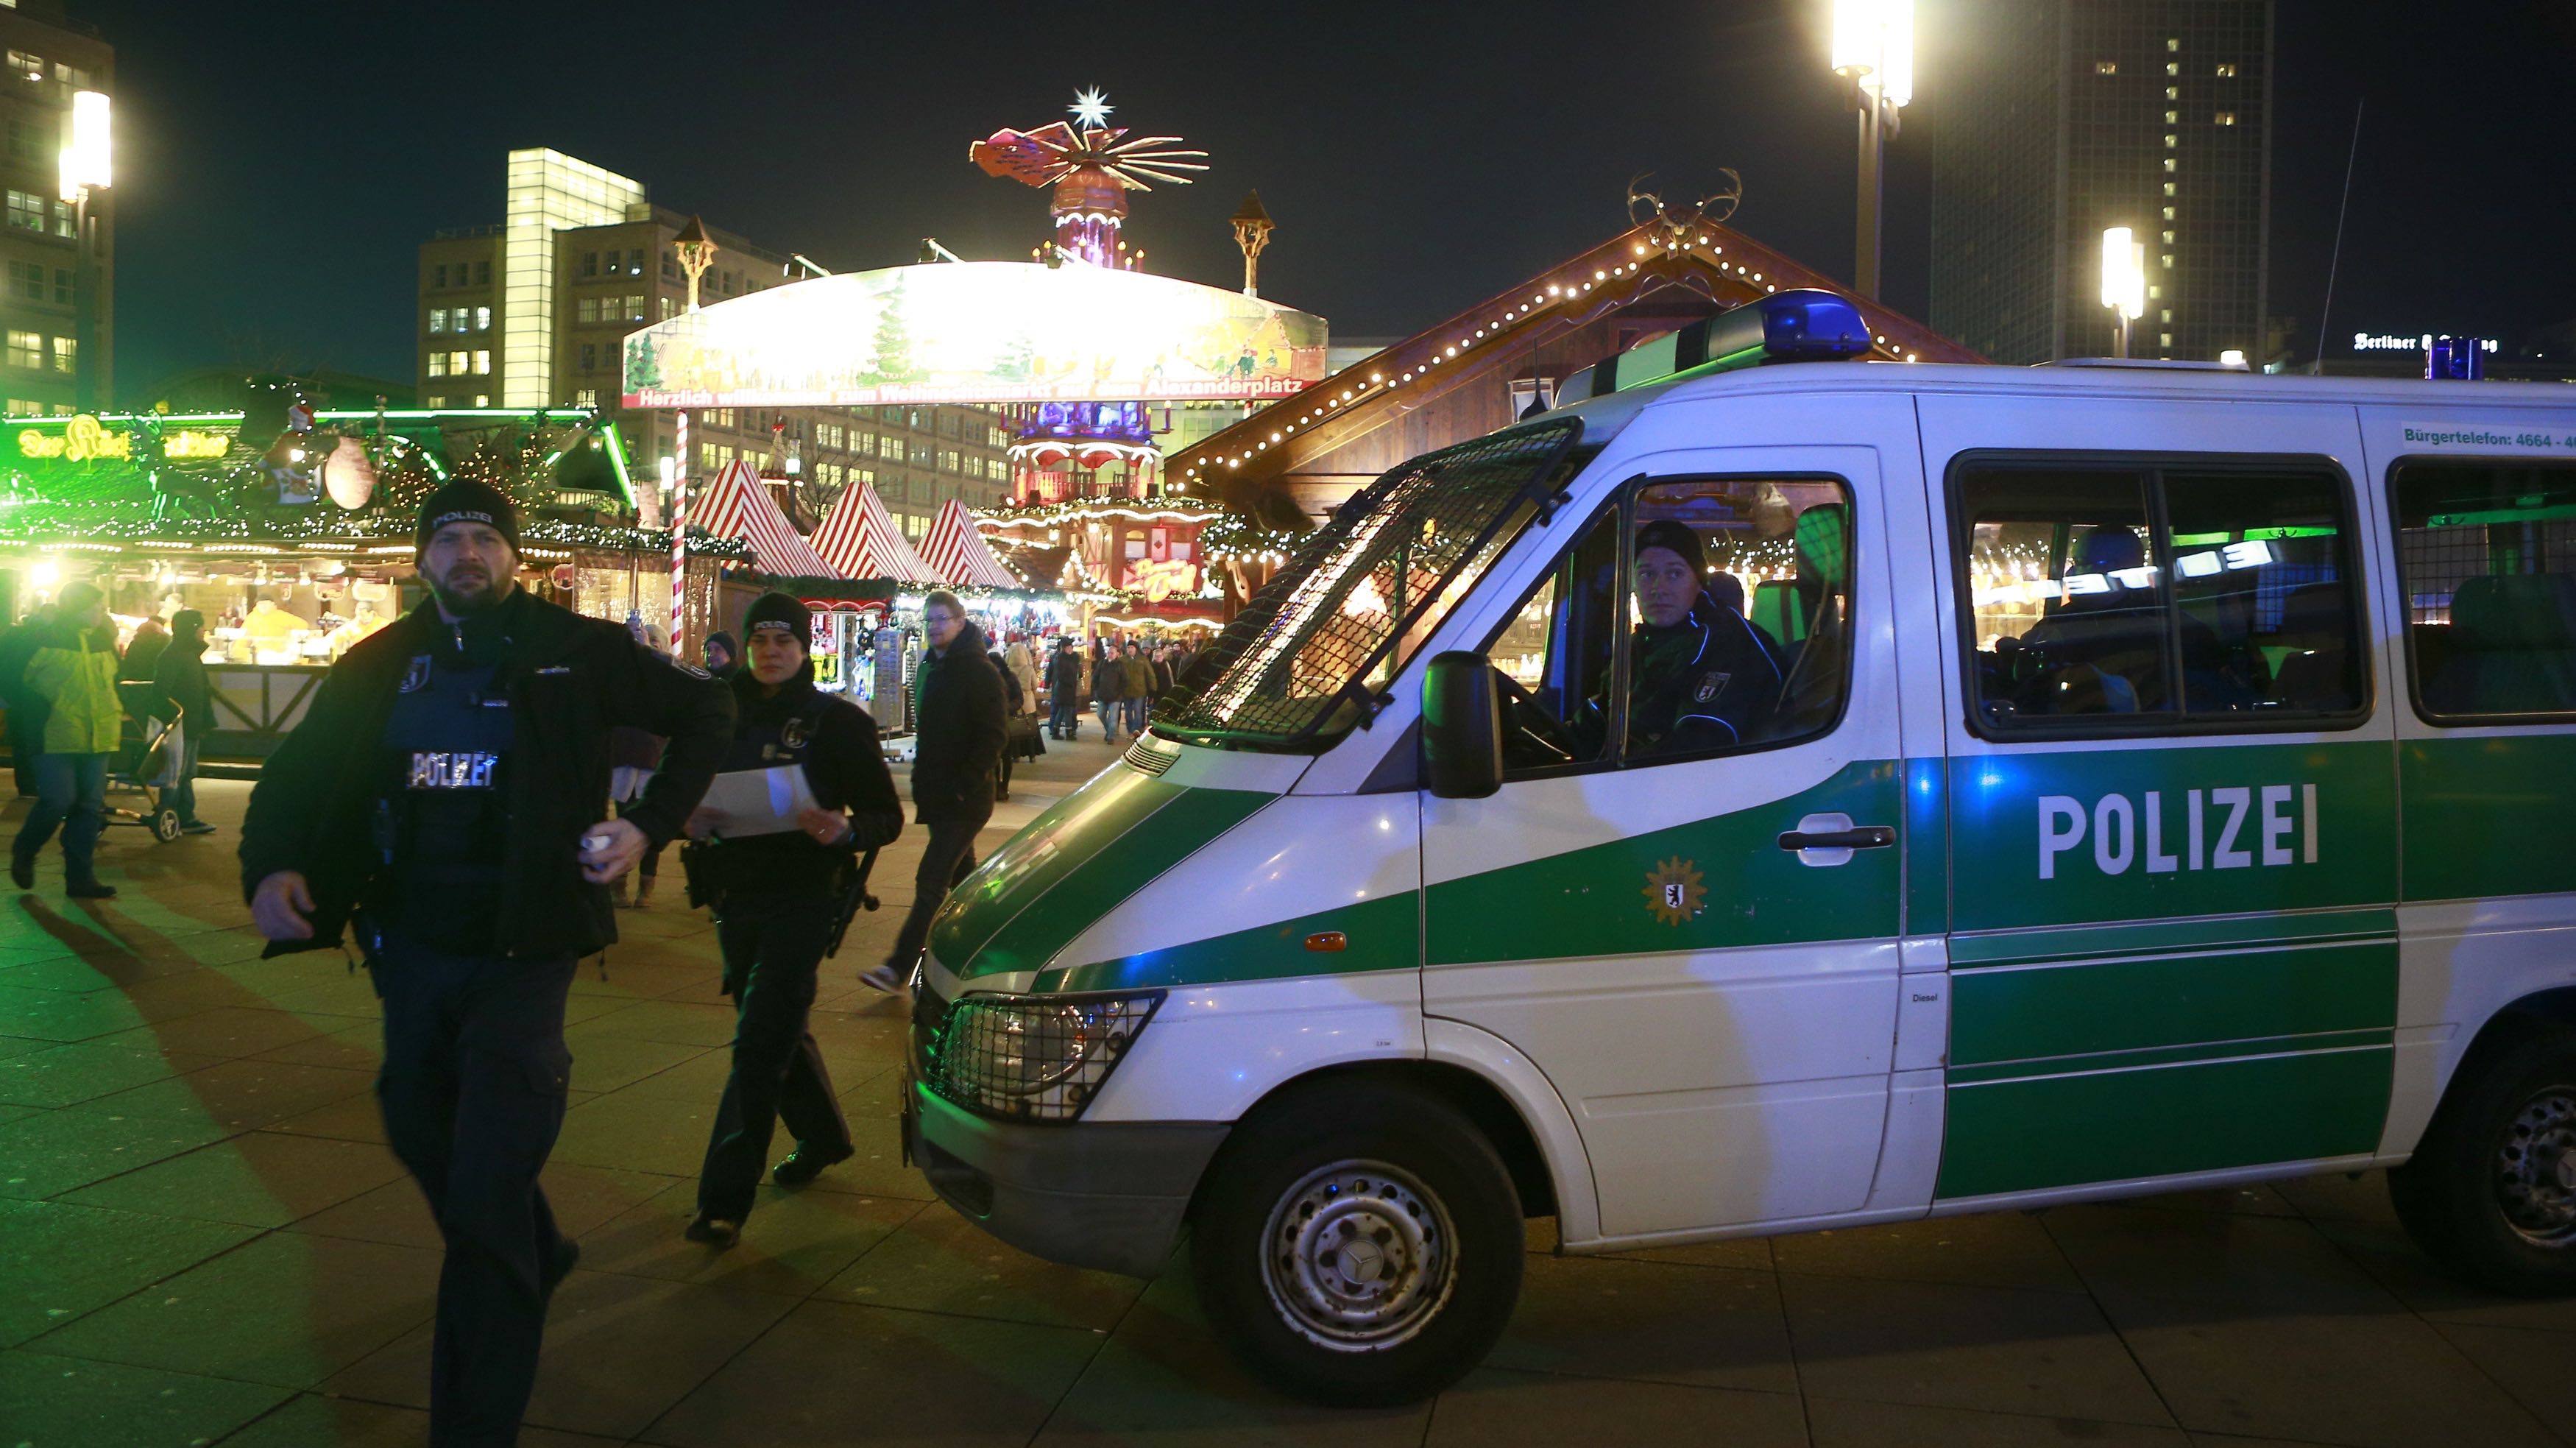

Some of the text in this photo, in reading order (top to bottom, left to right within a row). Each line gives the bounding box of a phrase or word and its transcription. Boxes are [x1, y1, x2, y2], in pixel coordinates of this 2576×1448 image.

[2354, 333, 2416, 350] Berliner
[640, 389, 713, 406] Herzlich
[836, 391, 876, 403] zum
[1058, 378, 1091, 397] auf
[1145, 376, 1303, 396] Alexanderplatz
[2405, 428, 2512, 445] Bürgertelefon:
[2516, 434, 2551, 448] 4664
[432, 511, 493, 528] POLIZEI
[411, 752, 495, 787] POLIZEI
[2038, 783, 2318, 879] POLIZEI
[1913, 994, 1938, 1002] Diesel
